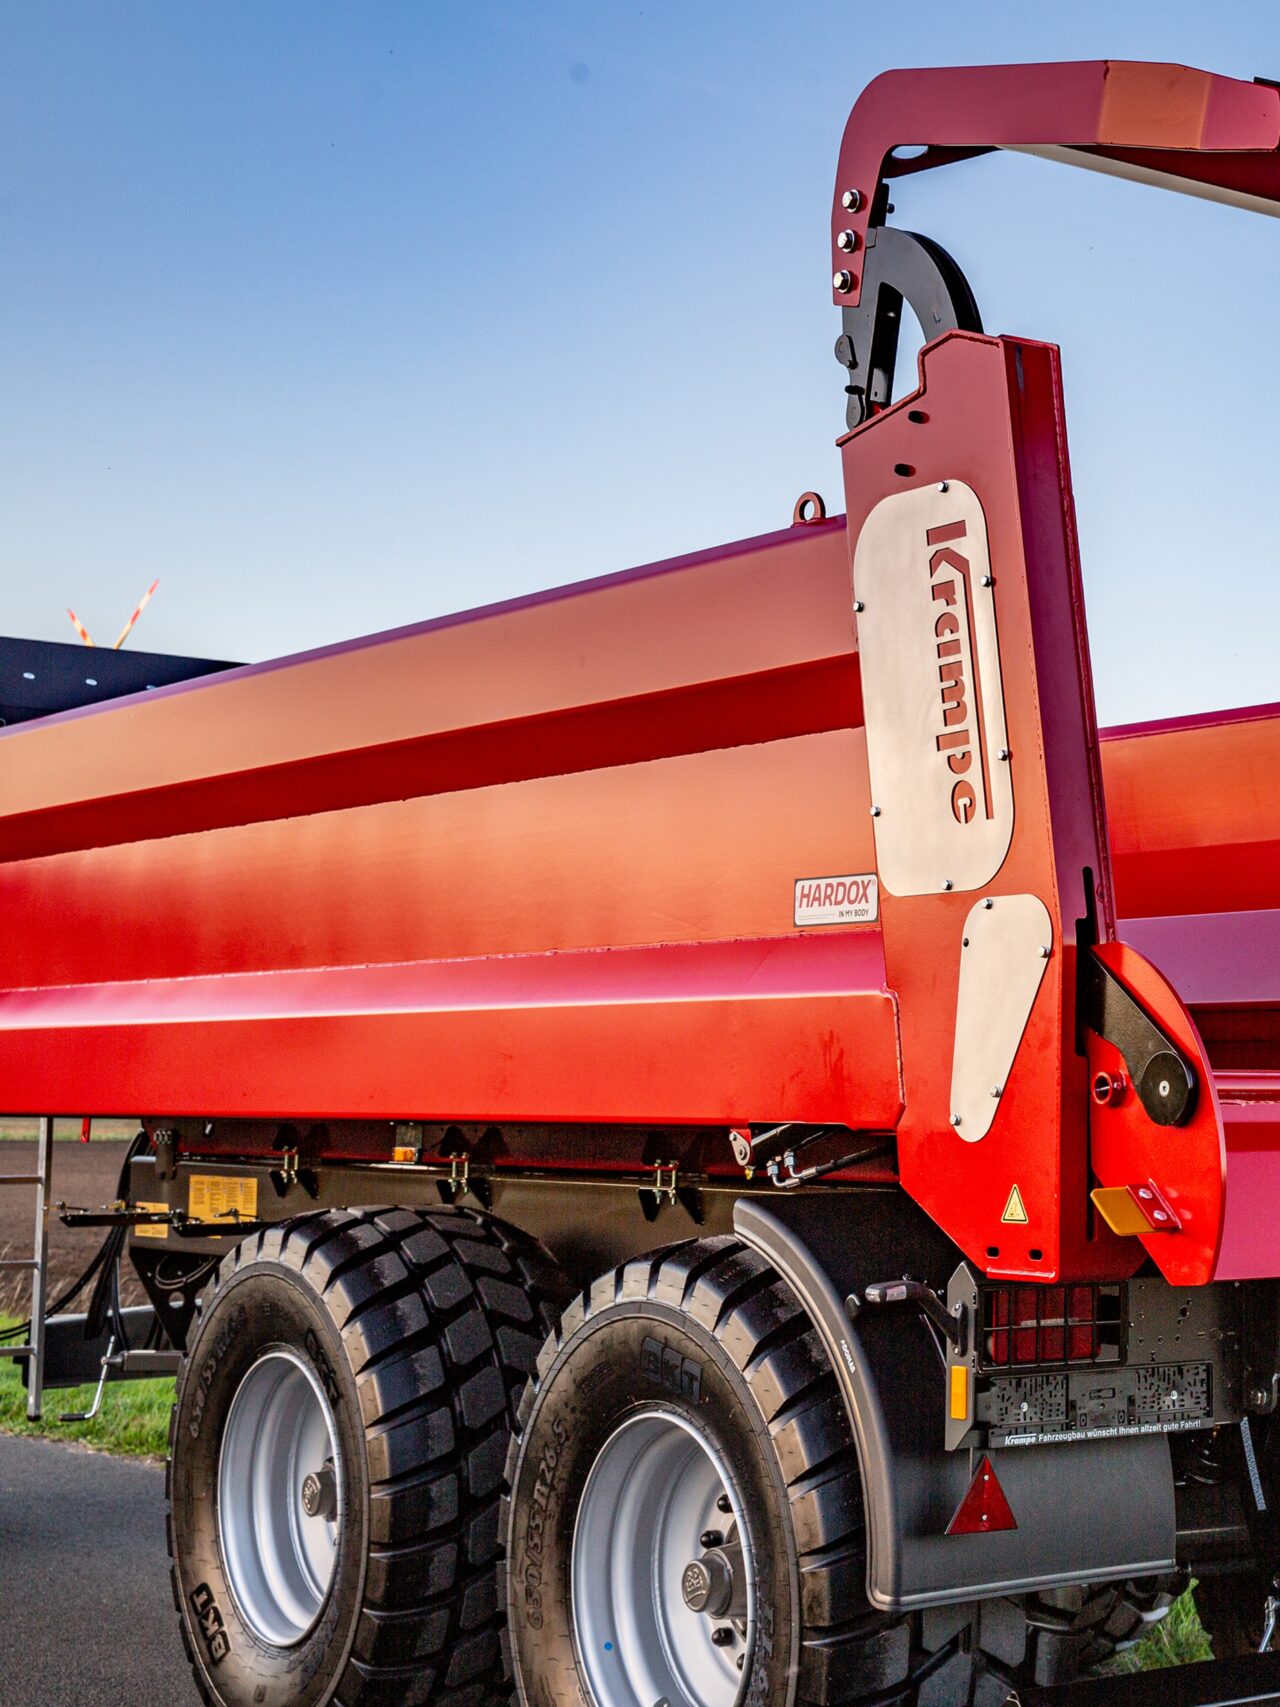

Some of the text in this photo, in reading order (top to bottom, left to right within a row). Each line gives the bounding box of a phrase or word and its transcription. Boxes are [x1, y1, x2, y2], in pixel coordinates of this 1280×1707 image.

[926, 520, 994, 824] Krampe
[798, 879, 872, 909] HARDOX
[854, 909, 869, 917] BODY
[1004, 1419, 1201, 1446] Krampe Fahrzeugbau wünscht Ihnen allzeit gute Fahrt!
[189, 1582, 231, 1666] BKT
